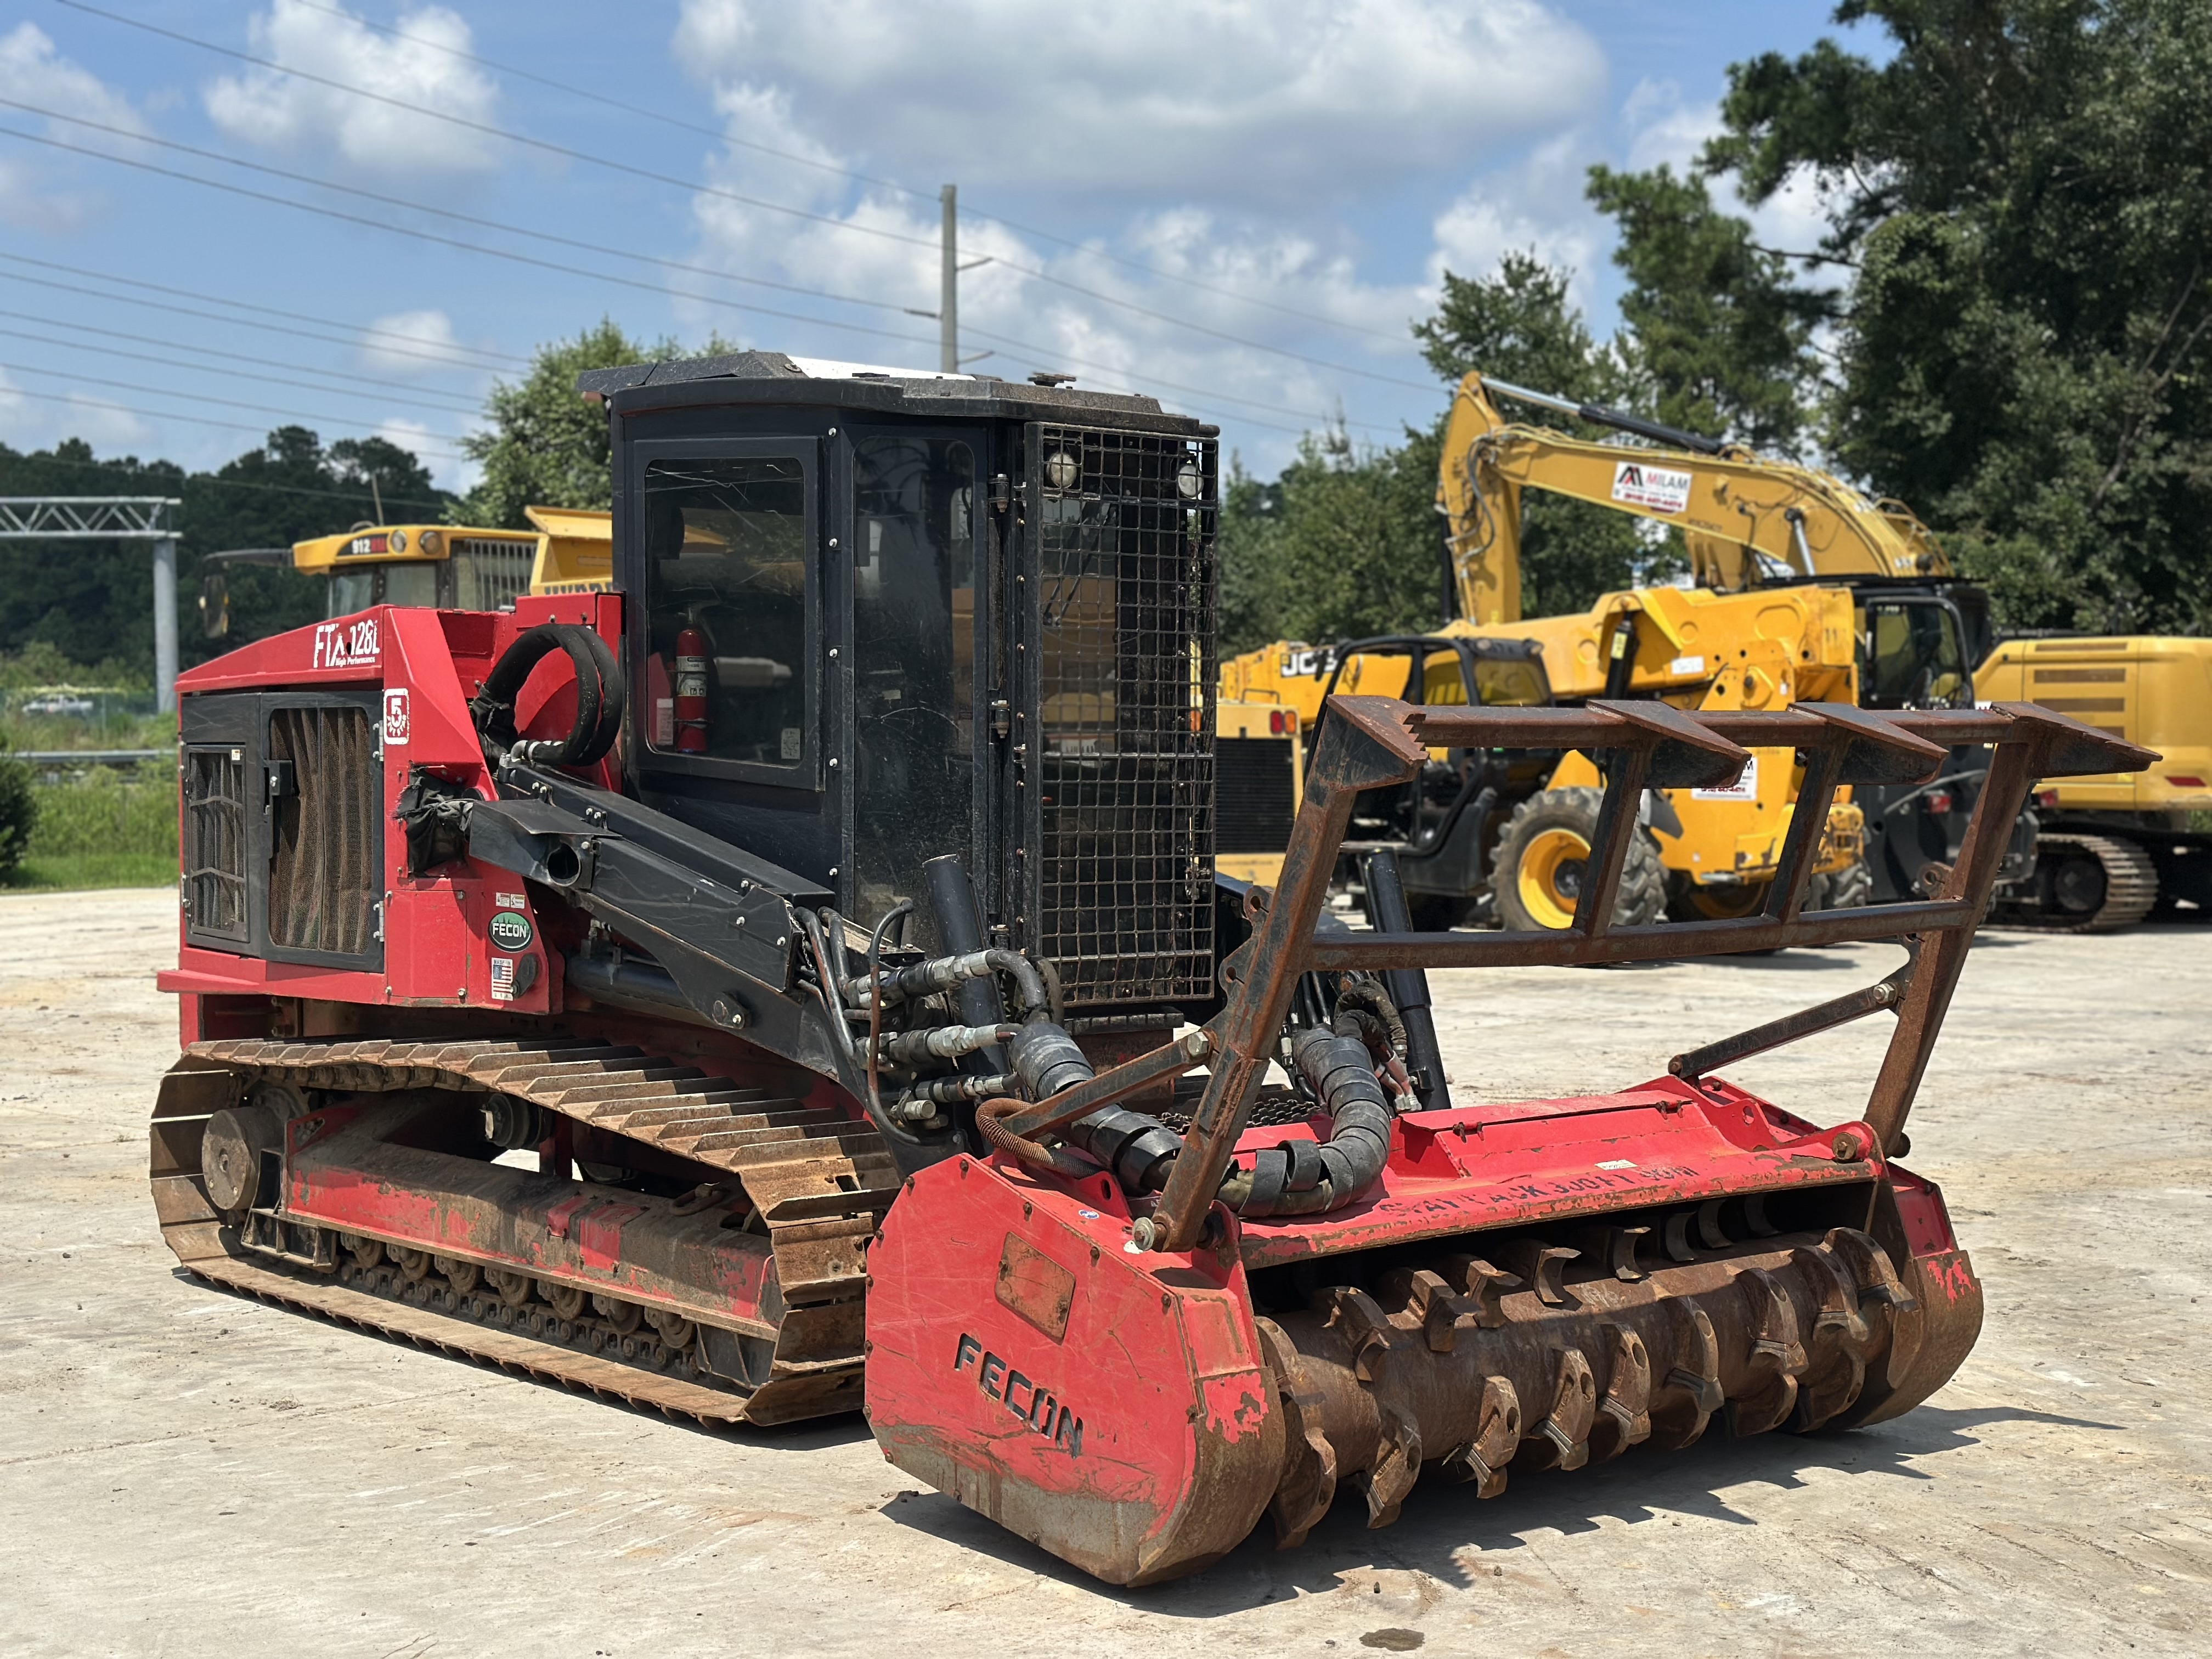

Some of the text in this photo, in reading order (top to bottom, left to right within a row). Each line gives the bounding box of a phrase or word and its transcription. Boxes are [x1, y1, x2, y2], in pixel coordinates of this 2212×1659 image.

[1646, 472, 1689, 490] MILAM
[493, 923, 527, 938] FECON
[954, 1333, 1084, 1459] FECON
